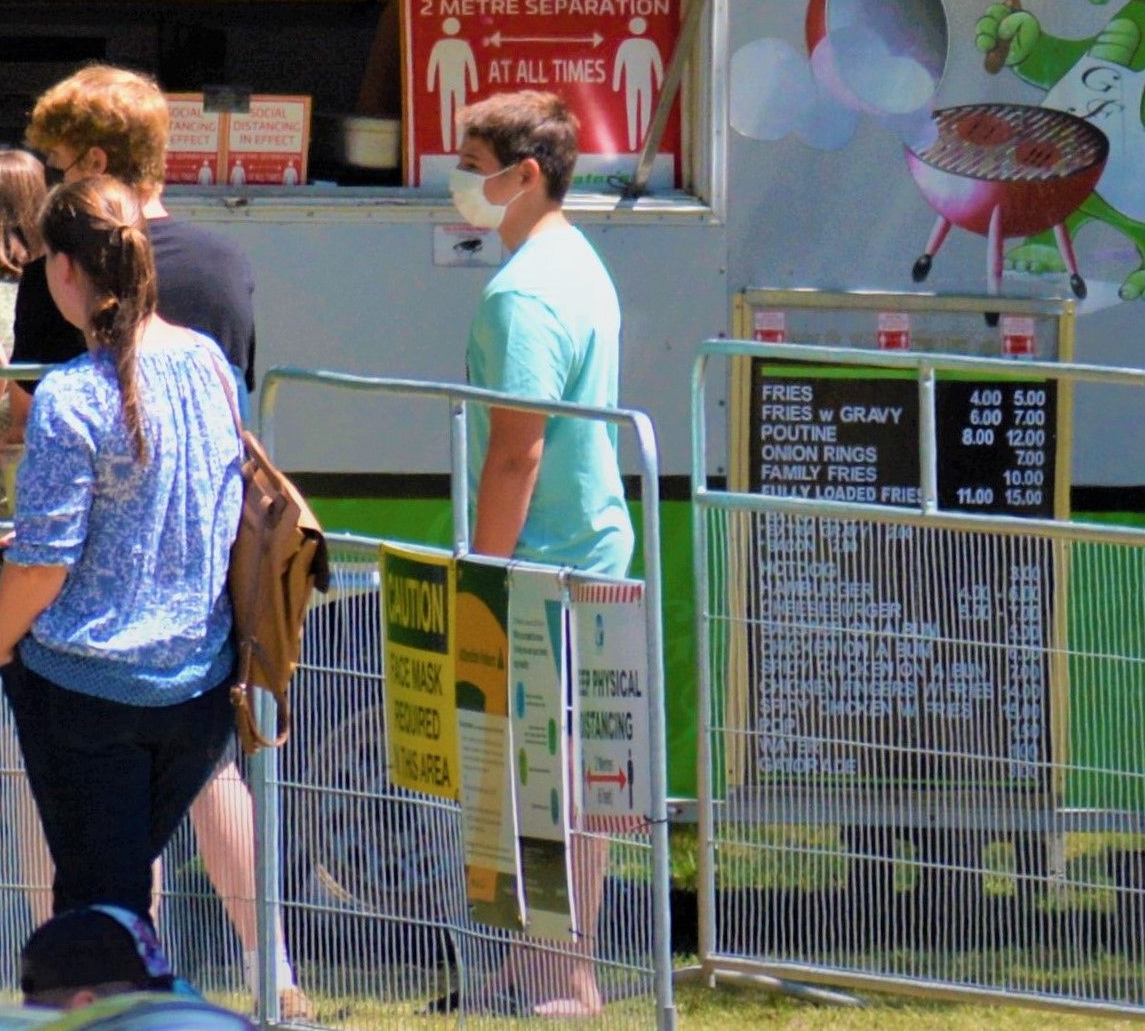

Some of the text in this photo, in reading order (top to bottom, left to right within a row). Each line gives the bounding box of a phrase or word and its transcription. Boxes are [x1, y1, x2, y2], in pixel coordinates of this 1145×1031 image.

[419, 0, 434, 17] 2
[488, 59, 606, 84] AT ALL TIMES
[169, 107, 204, 119] OCIAL
[169, 121, 217, 132] TANCING
[233, 120, 302, 132] DISTANCING
[240, 134, 296, 146] IN EFFECT
[762, 385, 1046, 407] FRIES 4.00 5.00
[762, 404, 1045, 426] FRIES w GRAVY 6.00 7.00
[760, 423, 1045, 447] POUTINE 8.00 12.00
[761, 445, 1044, 466] ONION RINGS 7.00
[761, 464, 1044, 486] FAMILY FRIES 10.00
[761, 484, 811, 498] FULLY
[816, 485, 876, 501] LOADED
[957, 488, 993, 504] 11.00
[1006, 489, 1042, 505] 15.00
[386, 575, 445, 635] CAUTION
[592, 670, 642, 698] PHYSICAL
[420, 753, 452, 789] AREA
